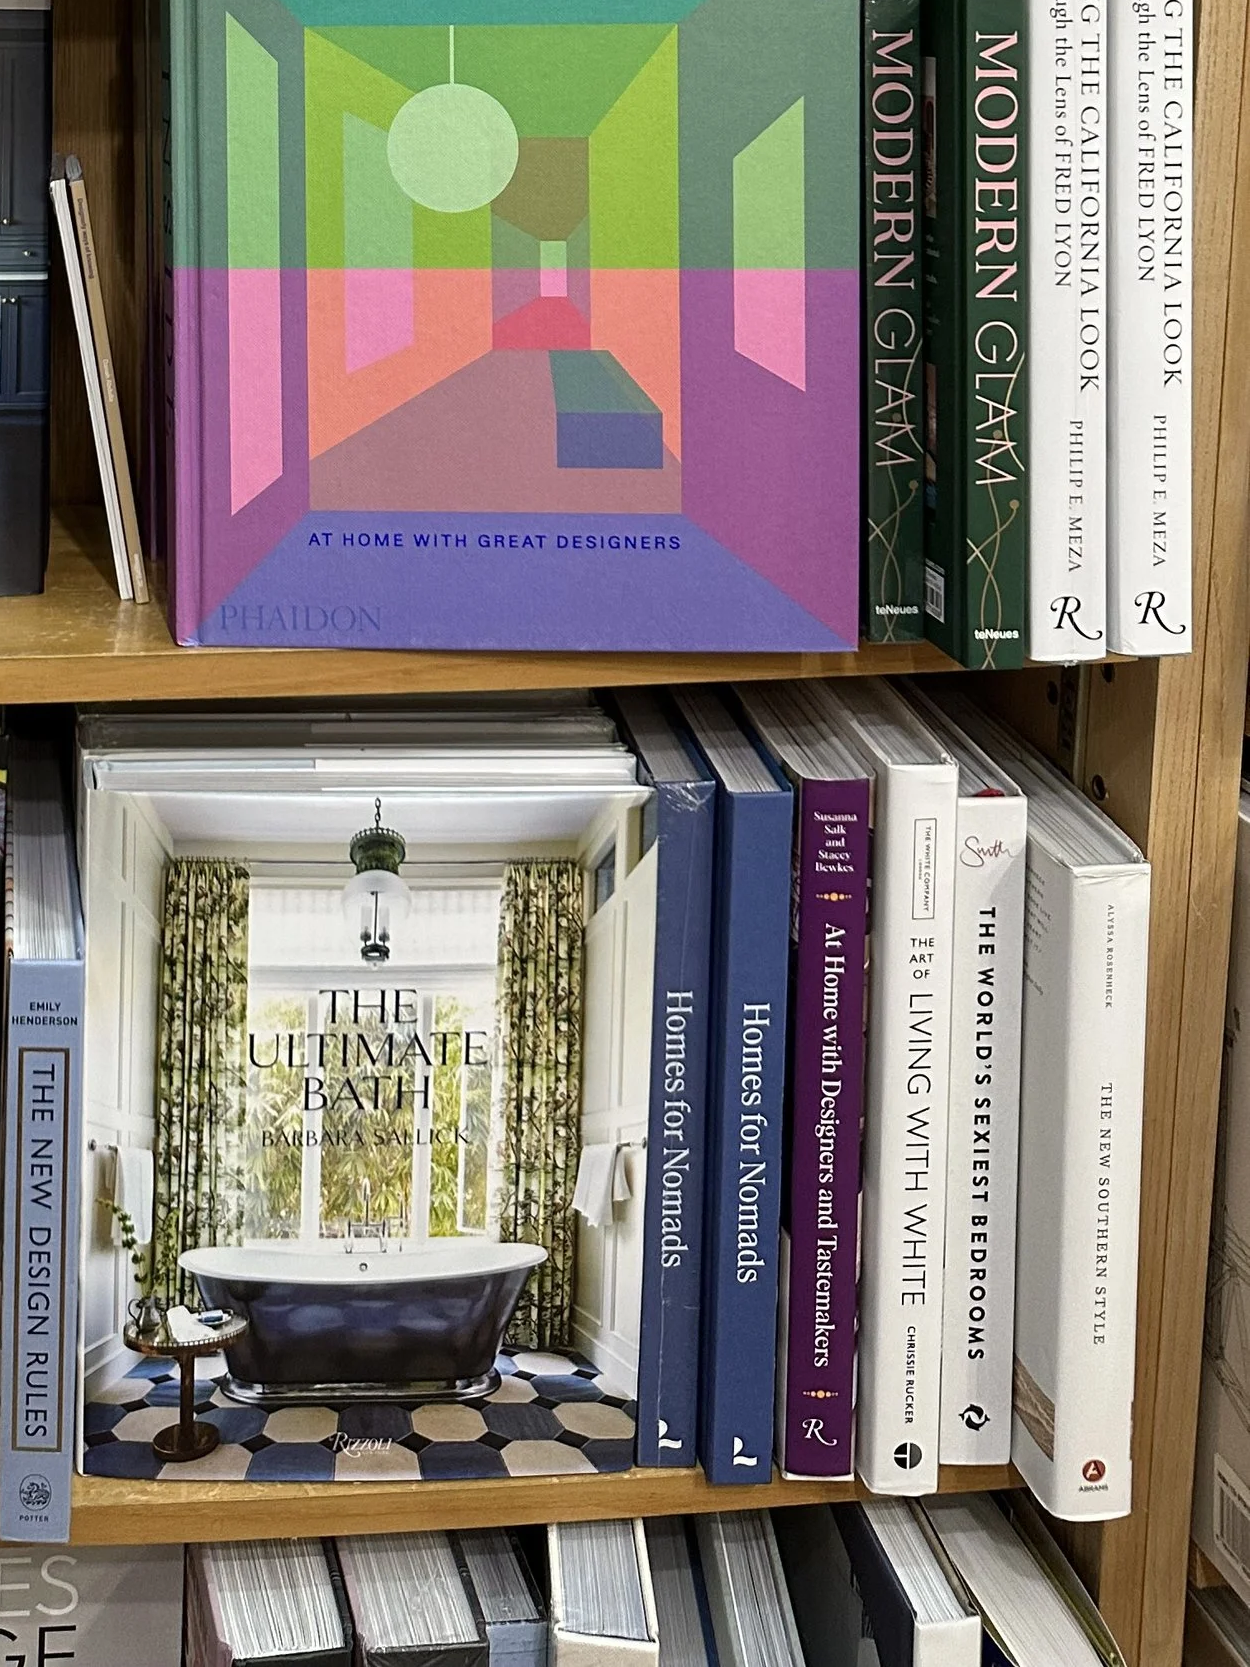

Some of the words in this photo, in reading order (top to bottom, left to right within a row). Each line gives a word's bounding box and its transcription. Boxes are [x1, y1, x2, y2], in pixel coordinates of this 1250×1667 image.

[1138, 32, 1156, 62] the
[1164, 29, 1183, 90] THE
[1138, 70, 1155, 113] Lens
[1138, 120, 1155, 140] of
[1138, 145, 1155, 208] FRED
[1163, 100, 1183, 292] CALIFORNIA
[1138, 217, 1155, 282] LYON
[1163, 303, 1182, 389] LOOK
[1153, 415, 1168, 483] PHILIP
[309, 532, 333, 546] AT
[343, 533, 404, 548] HOME
[414, 534, 467, 549] WITH
[478, 534, 546, 550] GREAT
[556, 535, 681, 551] DESIGNERS
[1152, 512, 1167, 568] MEZA
[814, 812, 858, 822] Susanna
[824, 824, 846, 835] Salk
[825, 836, 845, 847] and
[815, 862, 854, 873] Bewkes
[818, 850, 851, 861] Stacey
[824, 922, 846, 948] At
[910, 938, 934, 948] THE
[978, 907, 996, 955] THE
[910, 953, 934, 963] ART
[913, 969, 931, 979] OF
[29, 1002, 61, 1012] EMILY
[319, 989, 418, 1024] THE
[822, 955, 845, 1018] Home
[11, 1015, 78, 1026] HENDERSON
[907, 994, 933, 1094] LIVING
[973, 968, 994, 1085] WORLD'S
[249, 1031, 488, 1068] ULTIMATE
[821, 1023, 842, 1073] with
[31, 1063, 54, 1122] THE
[303, 1076, 430, 1111] BATH
[1101, 1083, 1113, 1119] THE
[815, 1080, 842, 1183] Designers
[905, 1107, 930, 1192] WITH
[972, 1098, 991, 1202] SEXIEST
[1099, 1128, 1111, 1168] NEW
[30, 1139, 53, 1209] NEW
[818, 1189, 838, 1230] and
[1096, 1177, 1110, 1277] SOUTHERN
[902, 1204, 926, 1306] WHITE
[27, 1227, 51, 1335] DESIGN
[814, 1235, 838, 1368] Tastemakers
[968, 1215, 988, 1360] BEDROOMS
[1094, 1287, 1106, 1345] STYLE
[907, 1325, 916, 1369] CHRISSIE
[24, 1352, 49, 1437] RULES
[905, 1371, 915, 1424] RUCKER
